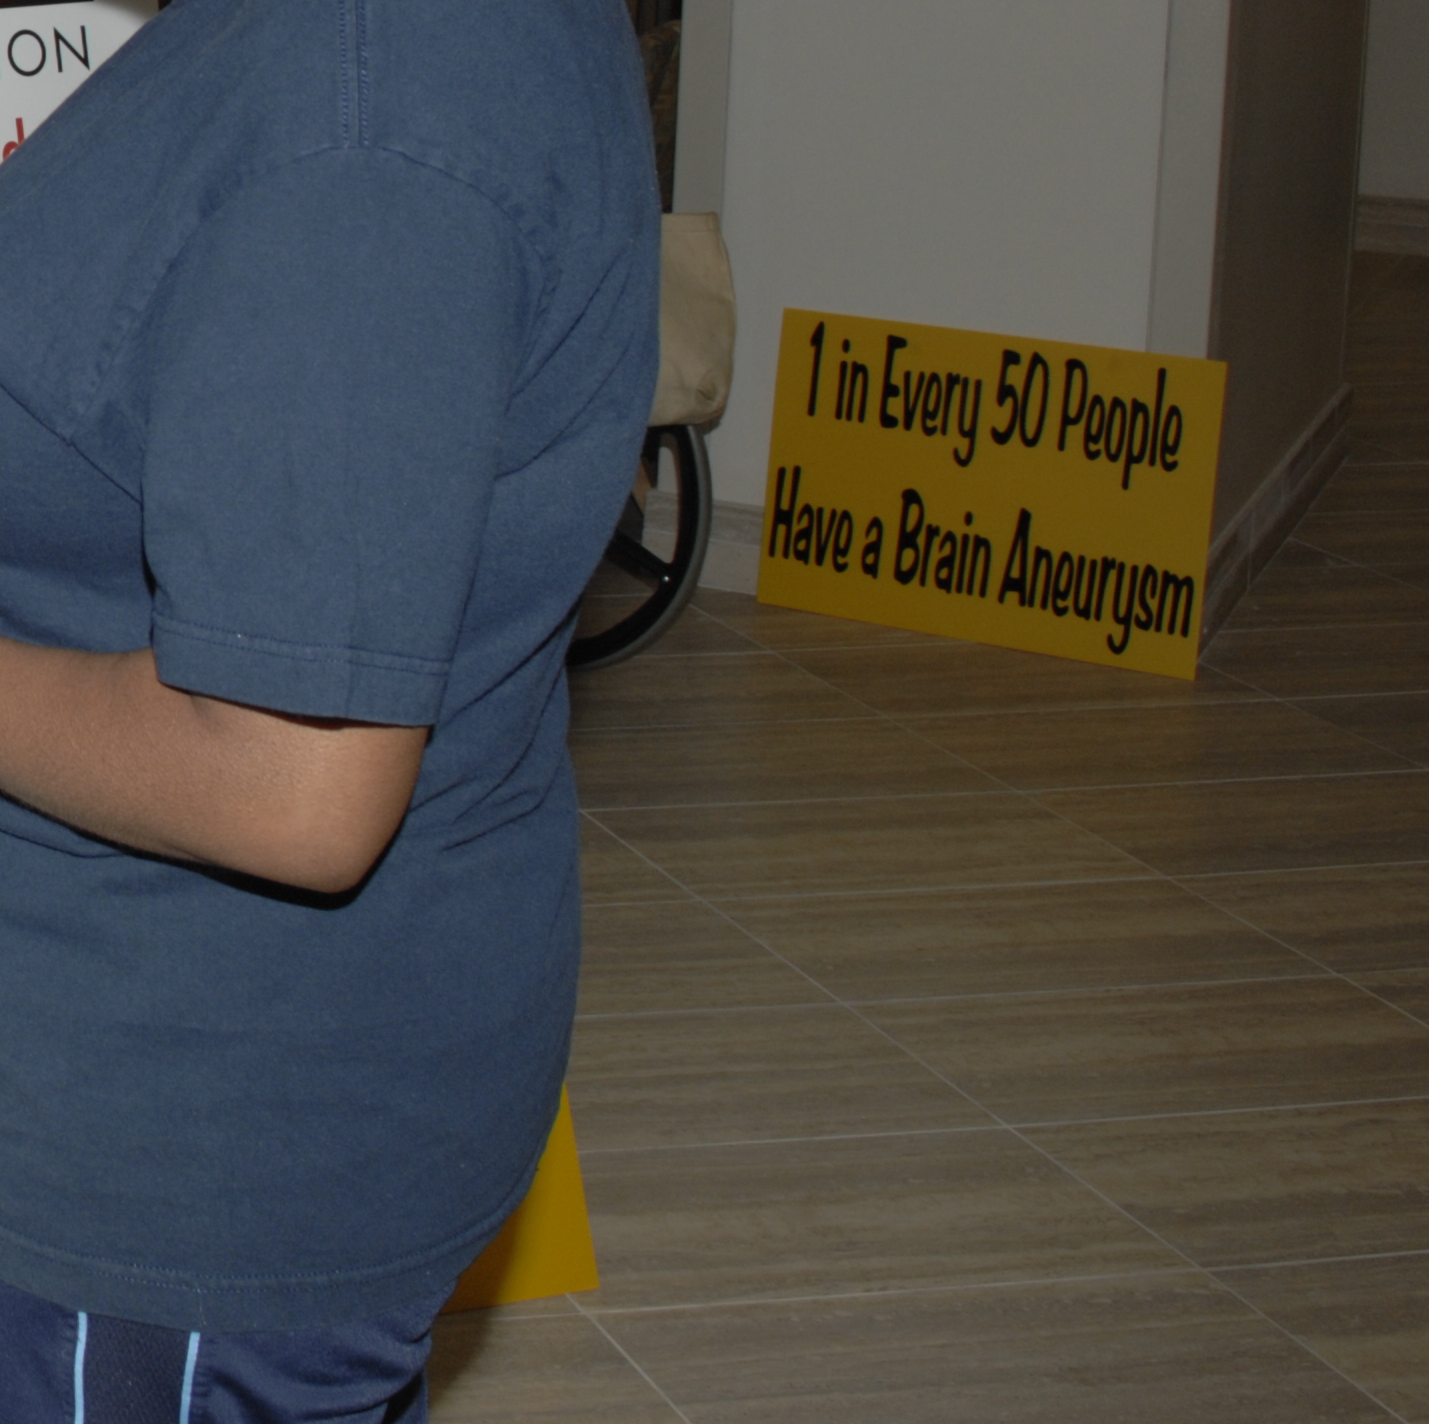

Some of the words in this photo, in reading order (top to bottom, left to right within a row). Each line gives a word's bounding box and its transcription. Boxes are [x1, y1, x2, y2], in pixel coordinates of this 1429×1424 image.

[807, 321, 825, 417] 1
[835, 339, 869, 424] in
[879, 334, 983, 468] Every
[990, 348, 1050, 449] 50
[1057, 357, 1184, 491] People
[768, 465, 854, 574] Have
[861, 516, 884, 579] a
[893, 487, 992, 599] Brain
[998, 507, 1195, 656] Aneurysm
